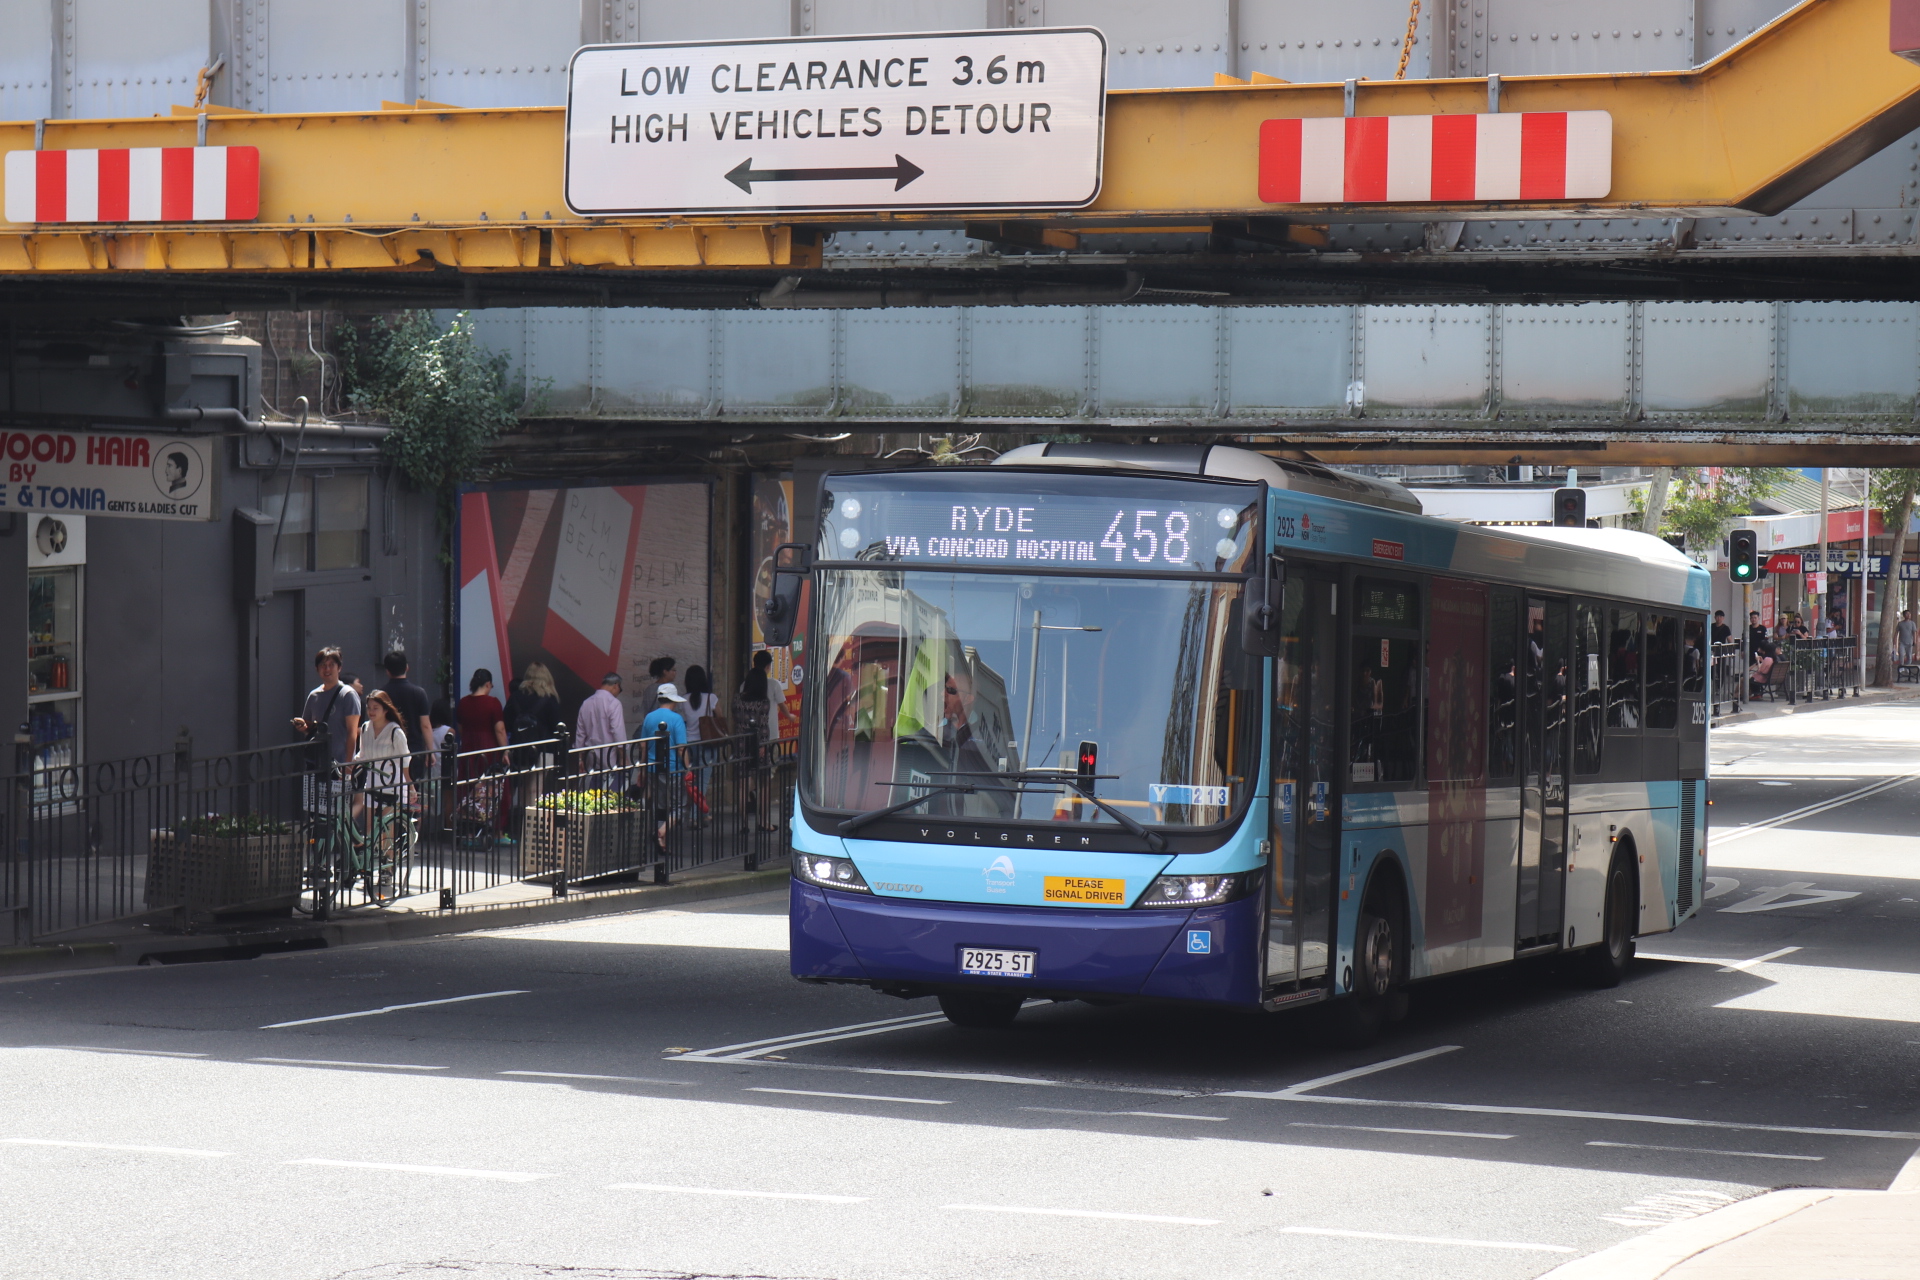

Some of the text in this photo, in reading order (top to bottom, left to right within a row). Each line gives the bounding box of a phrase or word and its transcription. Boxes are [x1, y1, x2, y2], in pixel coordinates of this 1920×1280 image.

[620, 65, 690, 97] LOW
[710, 57, 930, 94] CLEARANCE
[610, 102, 1052, 144] HIGH VEHICLES DETOUR
[0, 432, 151, 468] OOD HAIR
[9, 463, 37, 483] BY
[107, 500, 136, 513] GENTS
[180, 504, 198, 516] CUT
[570, 494, 611, 543] PALM
[1277, 516, 1295, 538] 2925
[951, 505, 1190, 563] RYDE 458
[566, 523, 618, 581] BEACH
[885, 536, 1097, 561] VIA CONCORD HOSPITAL
[1374, 543, 1394, 556] EMERGENCY
[634, 561, 685, 589] PALM
[1776, 561, 1795, 570] ATM
[633, 597, 699, 628] BEACH
[793, 640, 803, 651] TAB
[793, 668, 802, 678] FOX
[1692, 702, 1706, 724] 2925
[1153, 786, 1227, 805] Y 213
[920, 828, 1090, 845] VOLGREN
[872, 880, 923, 893] VOLVO
[985, 878, 1016, 888] Transport
[986, 886, 1007, 894] Buses
[1064, 878, 1105, 889] PLEASE
[1045, 888, 1124, 901] SIGNAL DRIVER
